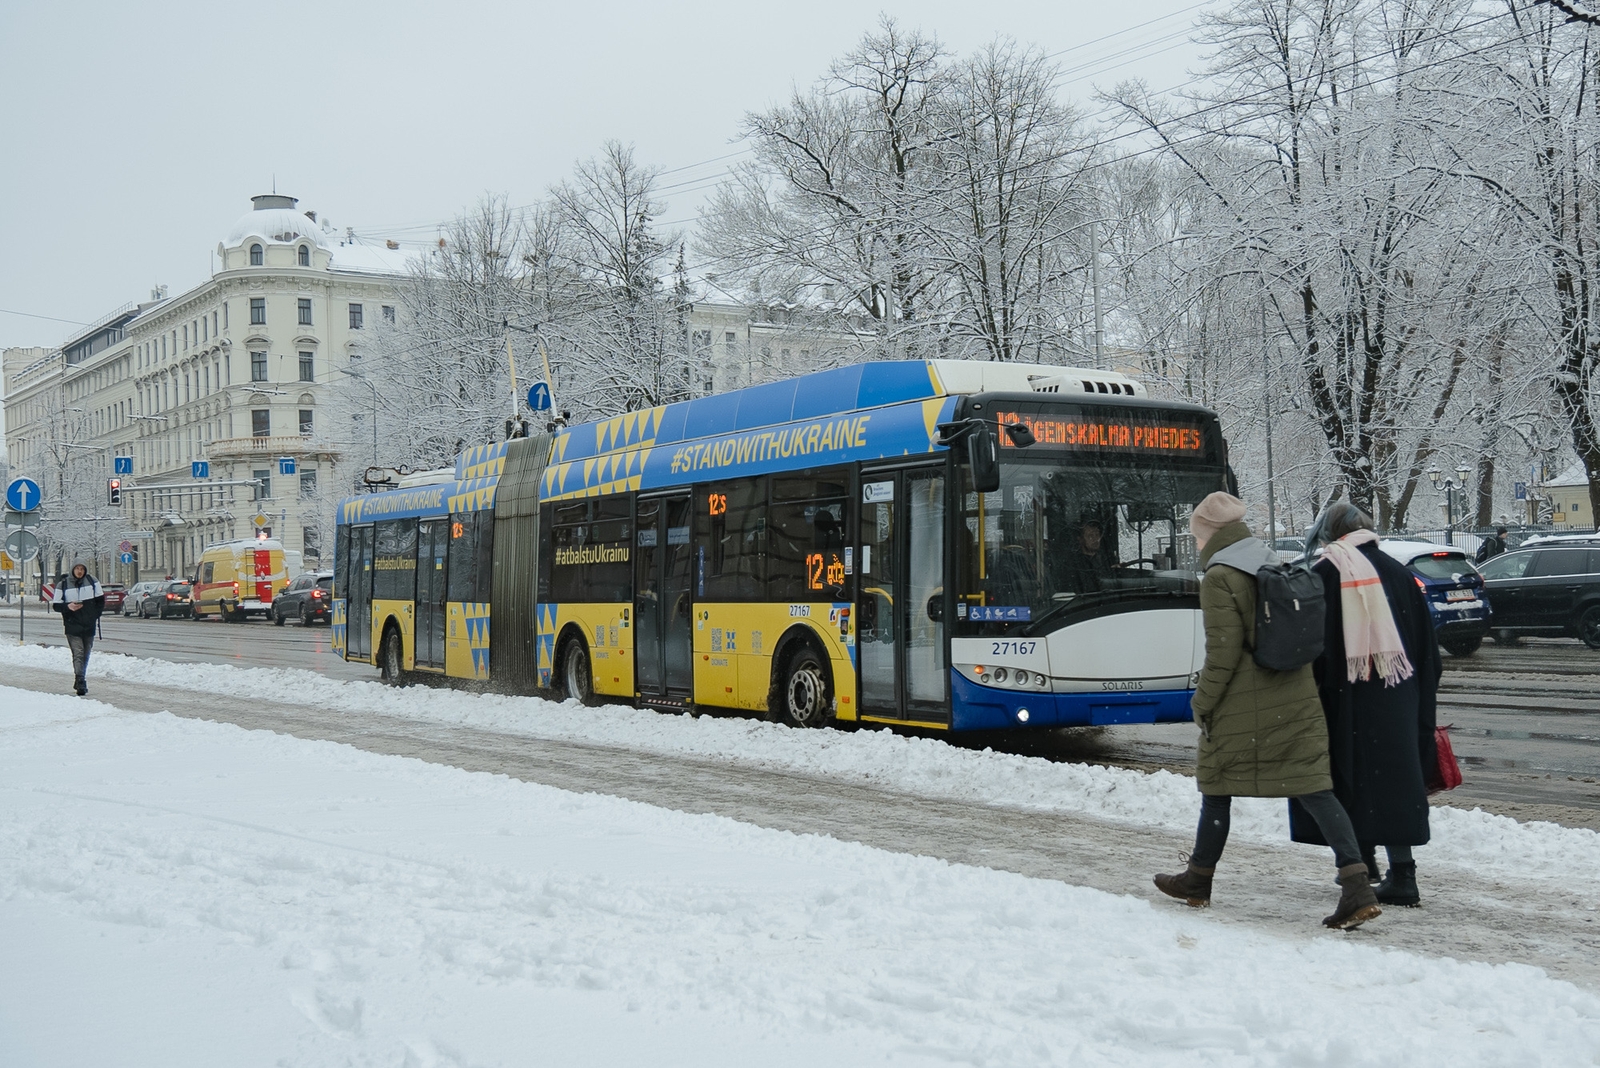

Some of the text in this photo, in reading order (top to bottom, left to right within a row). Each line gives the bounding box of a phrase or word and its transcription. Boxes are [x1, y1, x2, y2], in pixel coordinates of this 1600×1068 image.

[671, 416, 871, 474] #STANDWITHUKRAINE
[1134, 426, 1201, 450] PRIEDES
[364, 488, 445, 515] #STANDWITHUKRAINE
[556, 542, 629, 565] #atbalstuUkrainu
[806, 553, 824, 590] 12
[790, 605, 810, 617] 27167
[992, 641, 1036, 655] 27167
[711, 658, 728, 667] DONATE
[1102, 681, 1144, 691] SOLARIS
